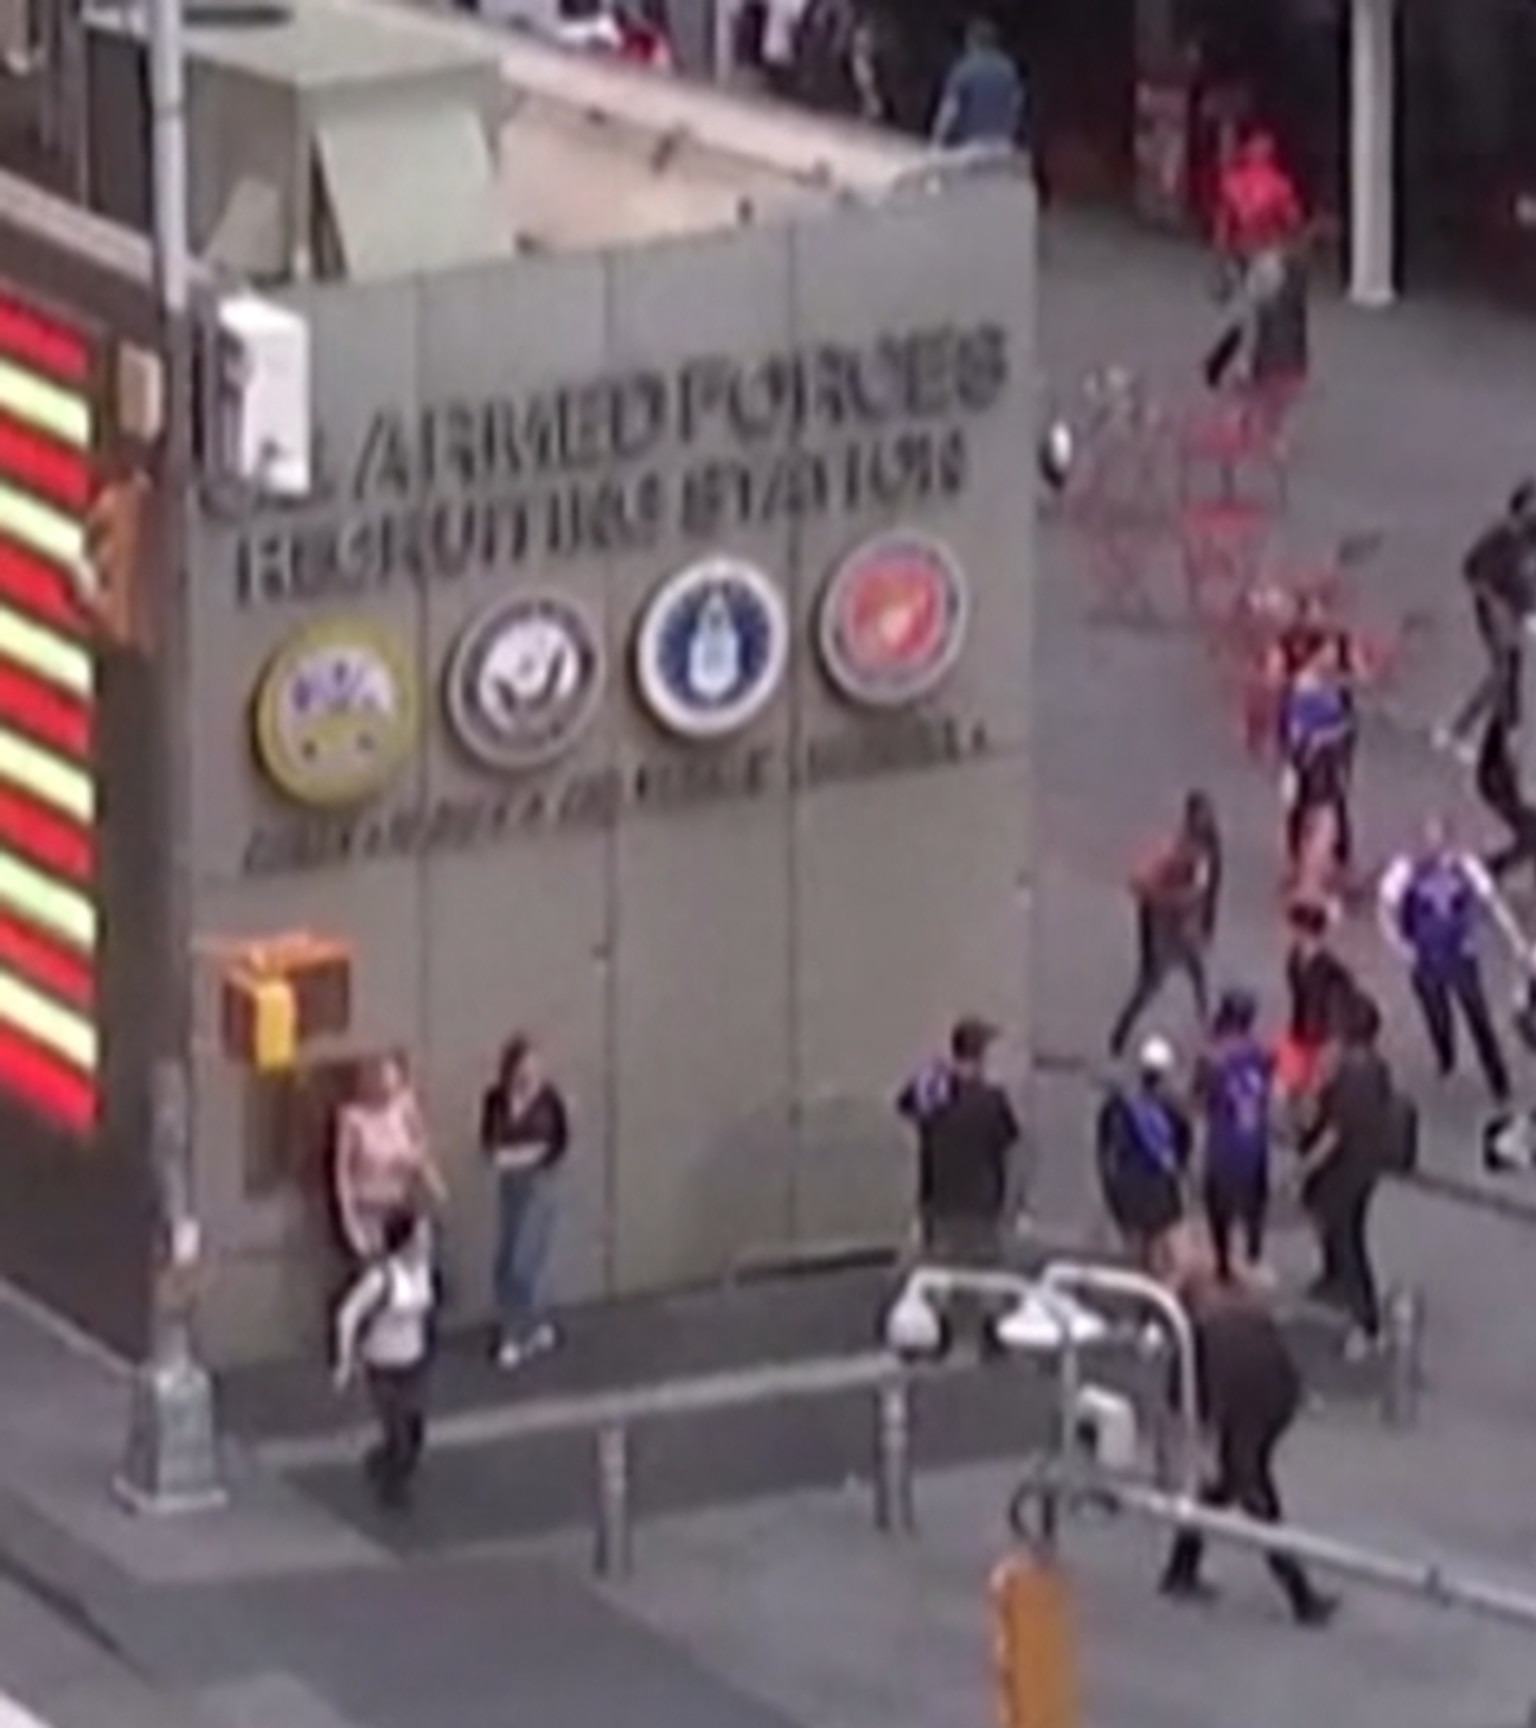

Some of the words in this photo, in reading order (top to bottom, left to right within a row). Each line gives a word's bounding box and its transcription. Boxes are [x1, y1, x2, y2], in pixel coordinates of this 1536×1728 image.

[354, 383, 664, 501] ARMED
[677, 326, 1010, 447] FORCES
[681, 428, 968, 537] STATION
